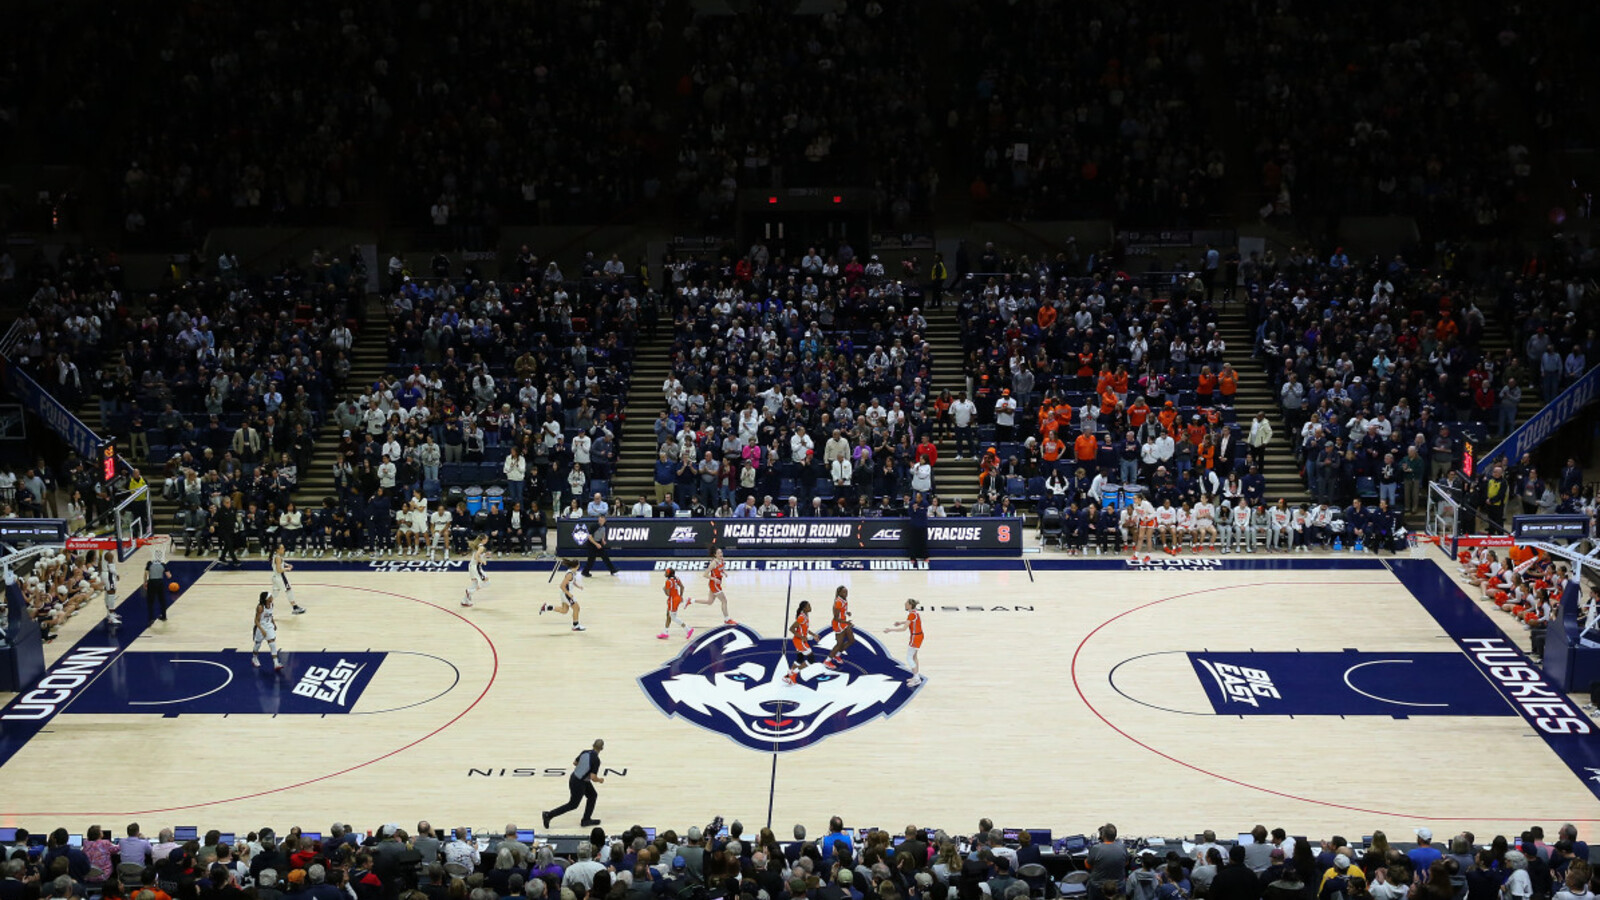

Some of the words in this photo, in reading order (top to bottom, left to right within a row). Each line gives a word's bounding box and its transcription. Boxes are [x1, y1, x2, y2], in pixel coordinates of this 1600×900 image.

[607, 527, 650, 541] UCONN
[723, 524, 755, 538] NCAA
[758, 524, 806, 538] SECOND
[809, 524, 852, 537] ROUND
[872, 529, 903, 541] ACC
[927, 527, 982, 541] YRACUSE
[997, 525, 1011, 542] S
[654, 560, 759, 570] BASKEBALL
[763, 560, 837, 570] CAPITAL
[869, 560, 930, 570] WORLD
[1, 647, 118, 720] UCONN
[292, 665, 331, 697] BIG
[314, 658, 359, 703] EAST
[1213, 661, 1260, 708] EAST
[1238, 666, 1282, 700] BIG
[1461, 637, 1591, 735] HUSKIES
[467, 768, 629, 777] NISSN
